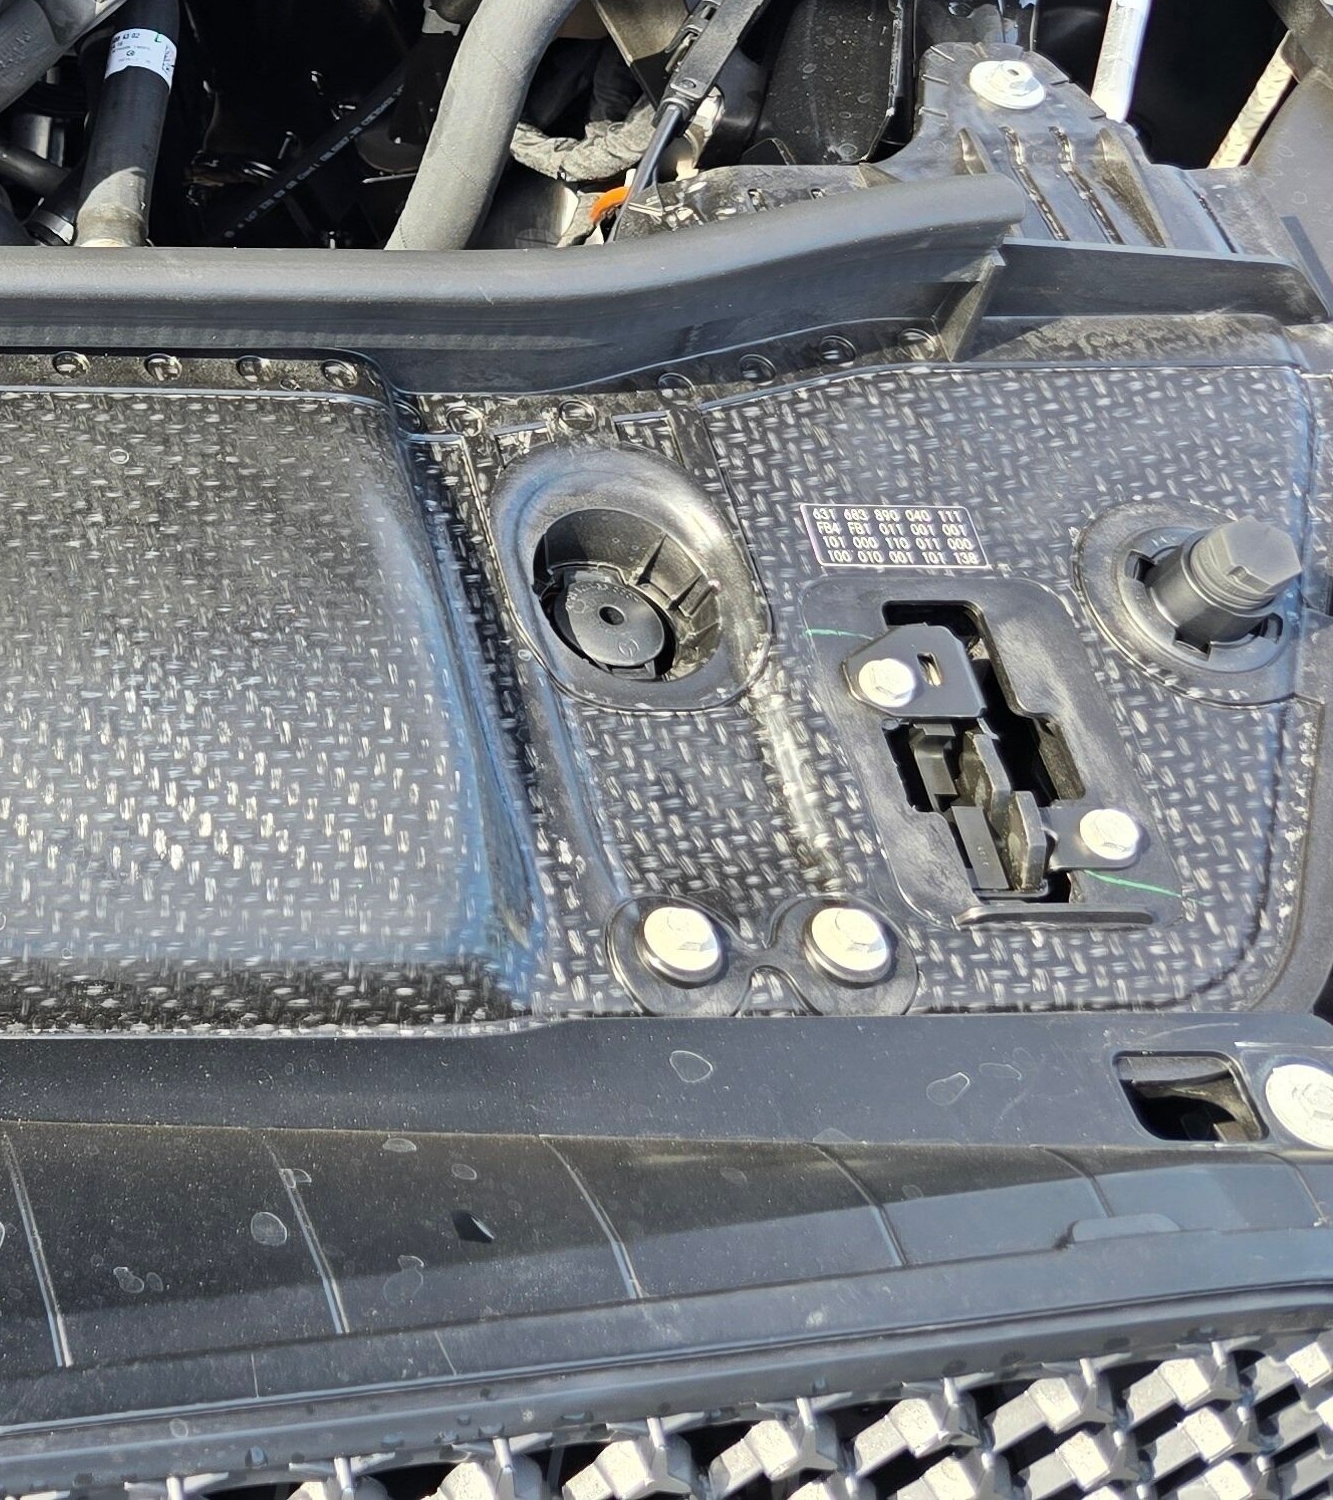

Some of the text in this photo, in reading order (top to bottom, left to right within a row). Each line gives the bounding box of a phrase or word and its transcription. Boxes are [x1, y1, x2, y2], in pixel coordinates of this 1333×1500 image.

[812, 508, 962, 522] 631 683 890 040 111
[816, 521, 967, 536] FB4 FB1 011 001 001
[823, 535, 976, 551] 101 000 110 011 000
[827, 550, 853, 563] 100
[857, 550, 884, 563] 010
[888, 551, 914, 564] 001
[922, 551, 946, 564] 101
